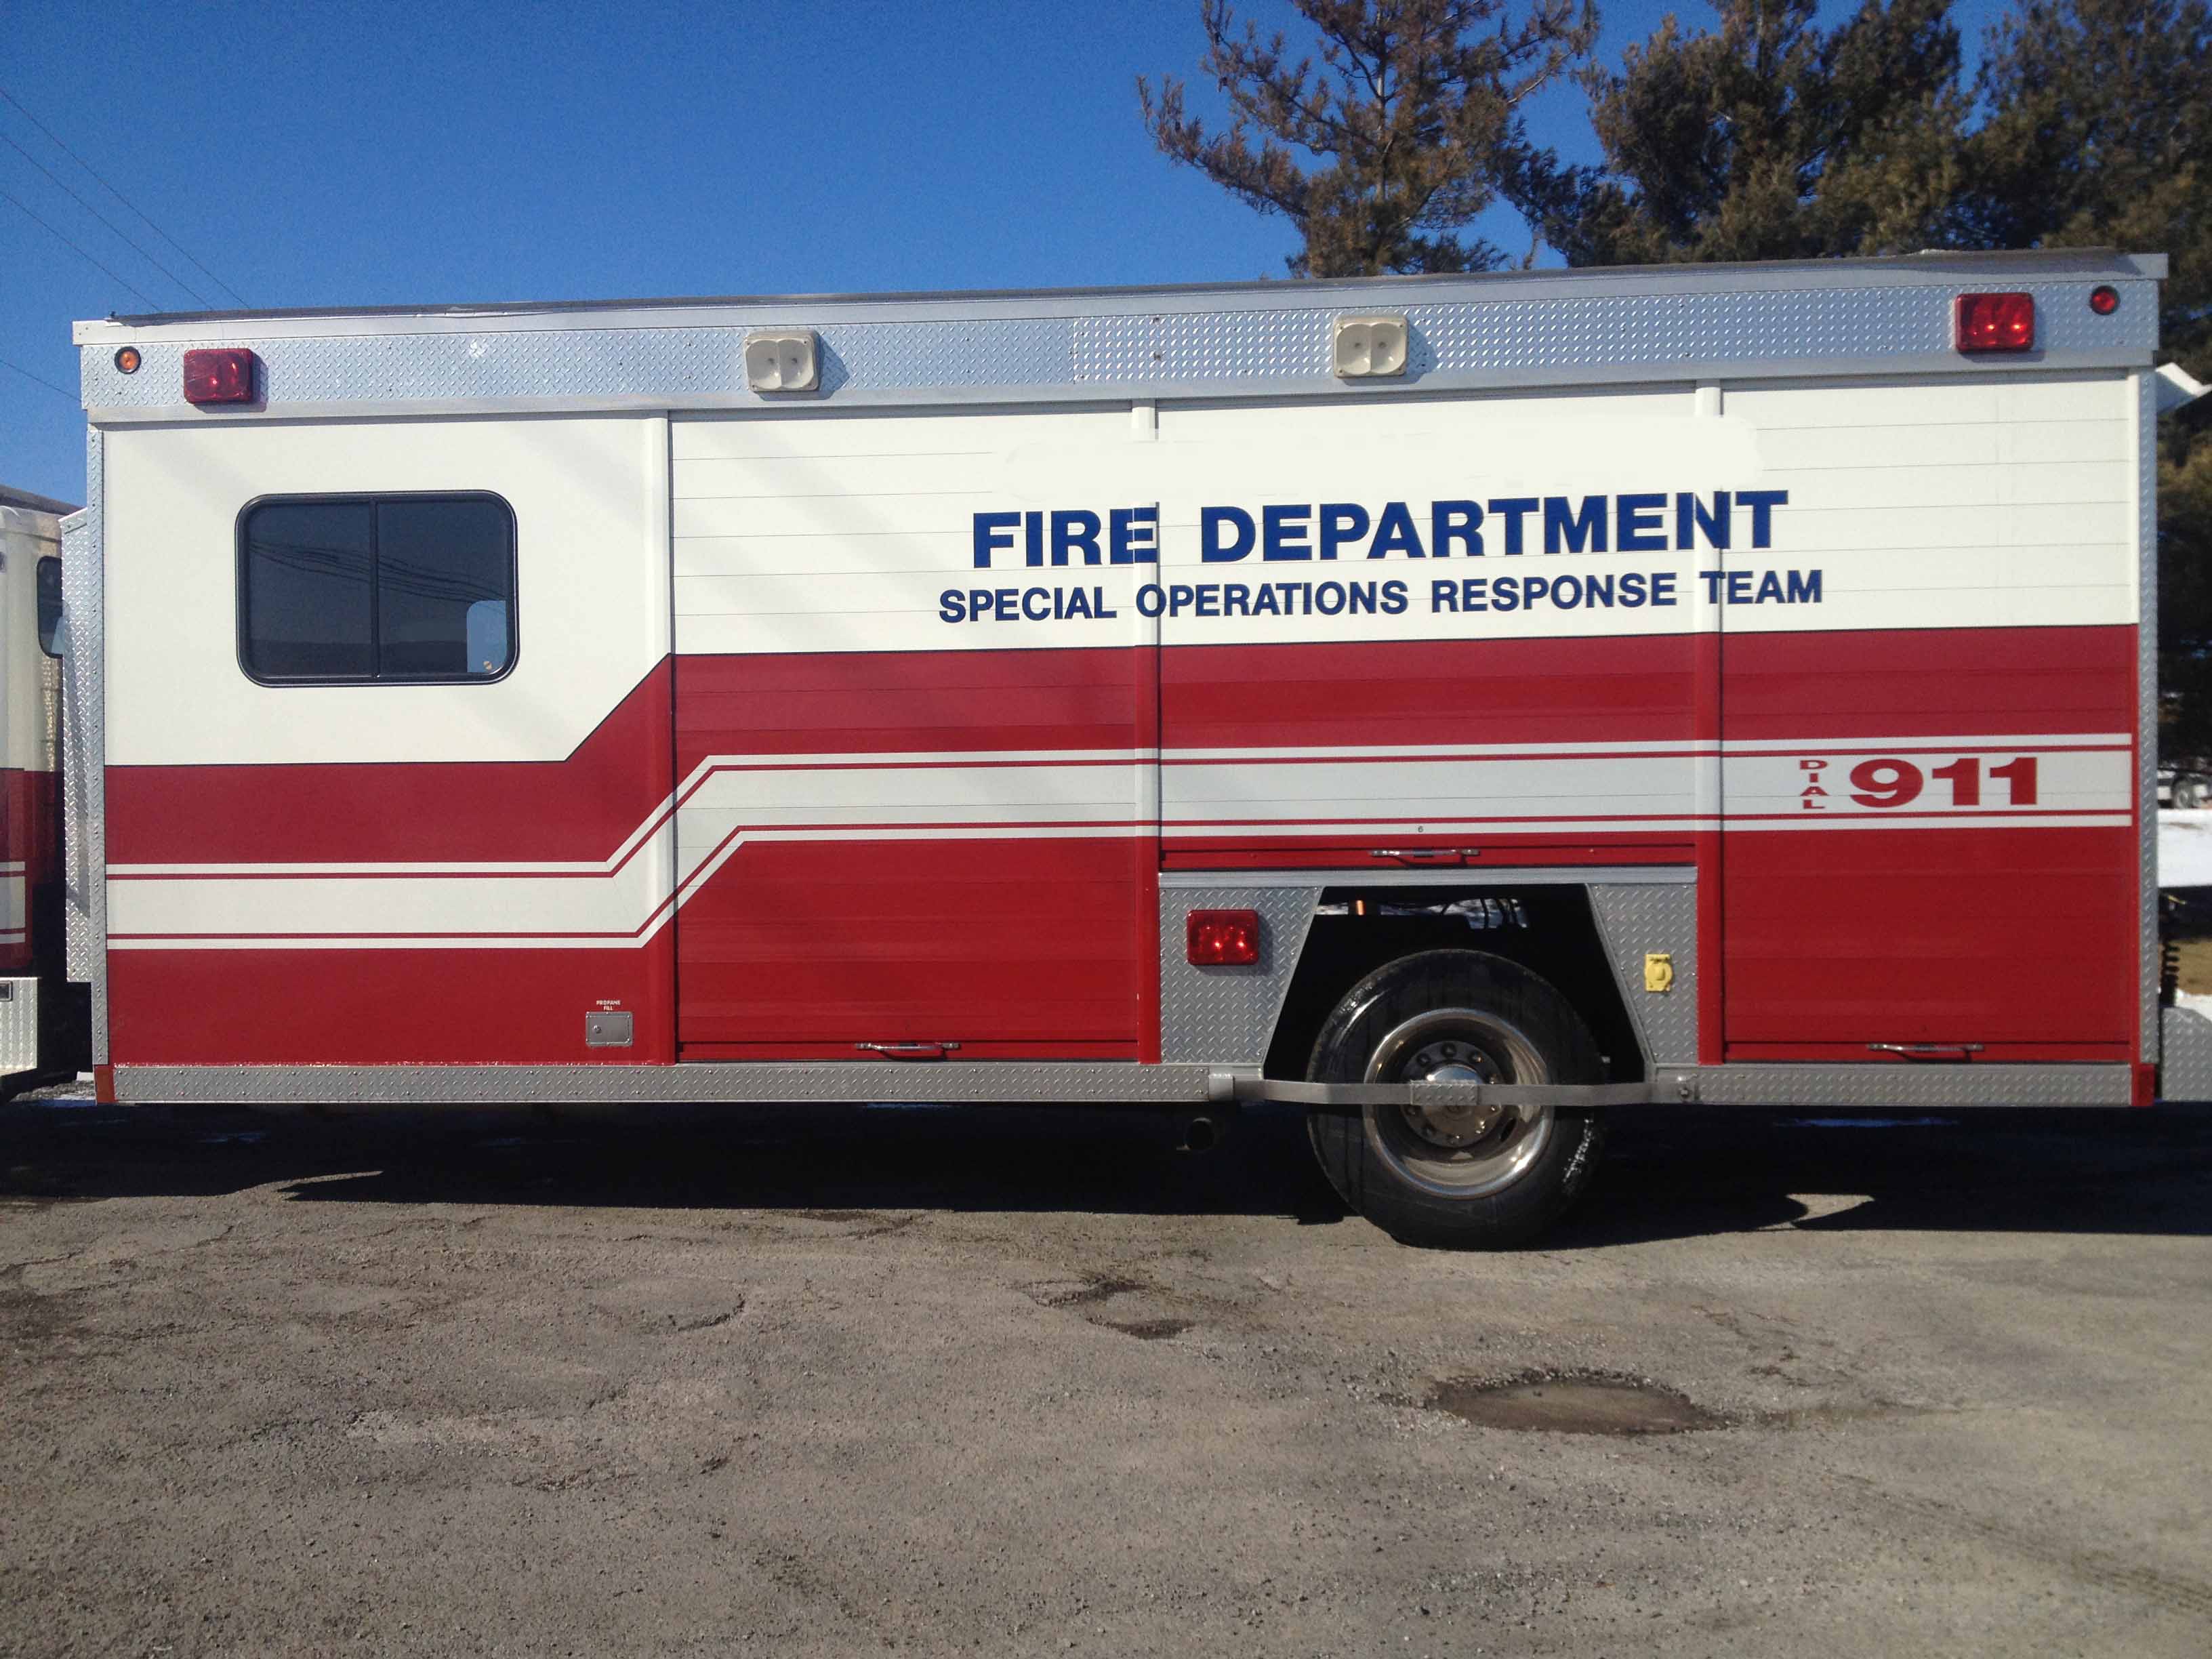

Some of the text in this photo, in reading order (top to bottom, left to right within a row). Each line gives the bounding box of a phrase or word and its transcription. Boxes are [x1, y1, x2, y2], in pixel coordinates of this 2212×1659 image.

[973, 490, 1788, 568] FIRE DEPARTMENT
[939, 569, 1822, 623] SPECIAL OPERATIONS RESPONSE TEAM
[1799, 760, 1828, 809] DIAL
[1849, 757, 2037, 808] 911
